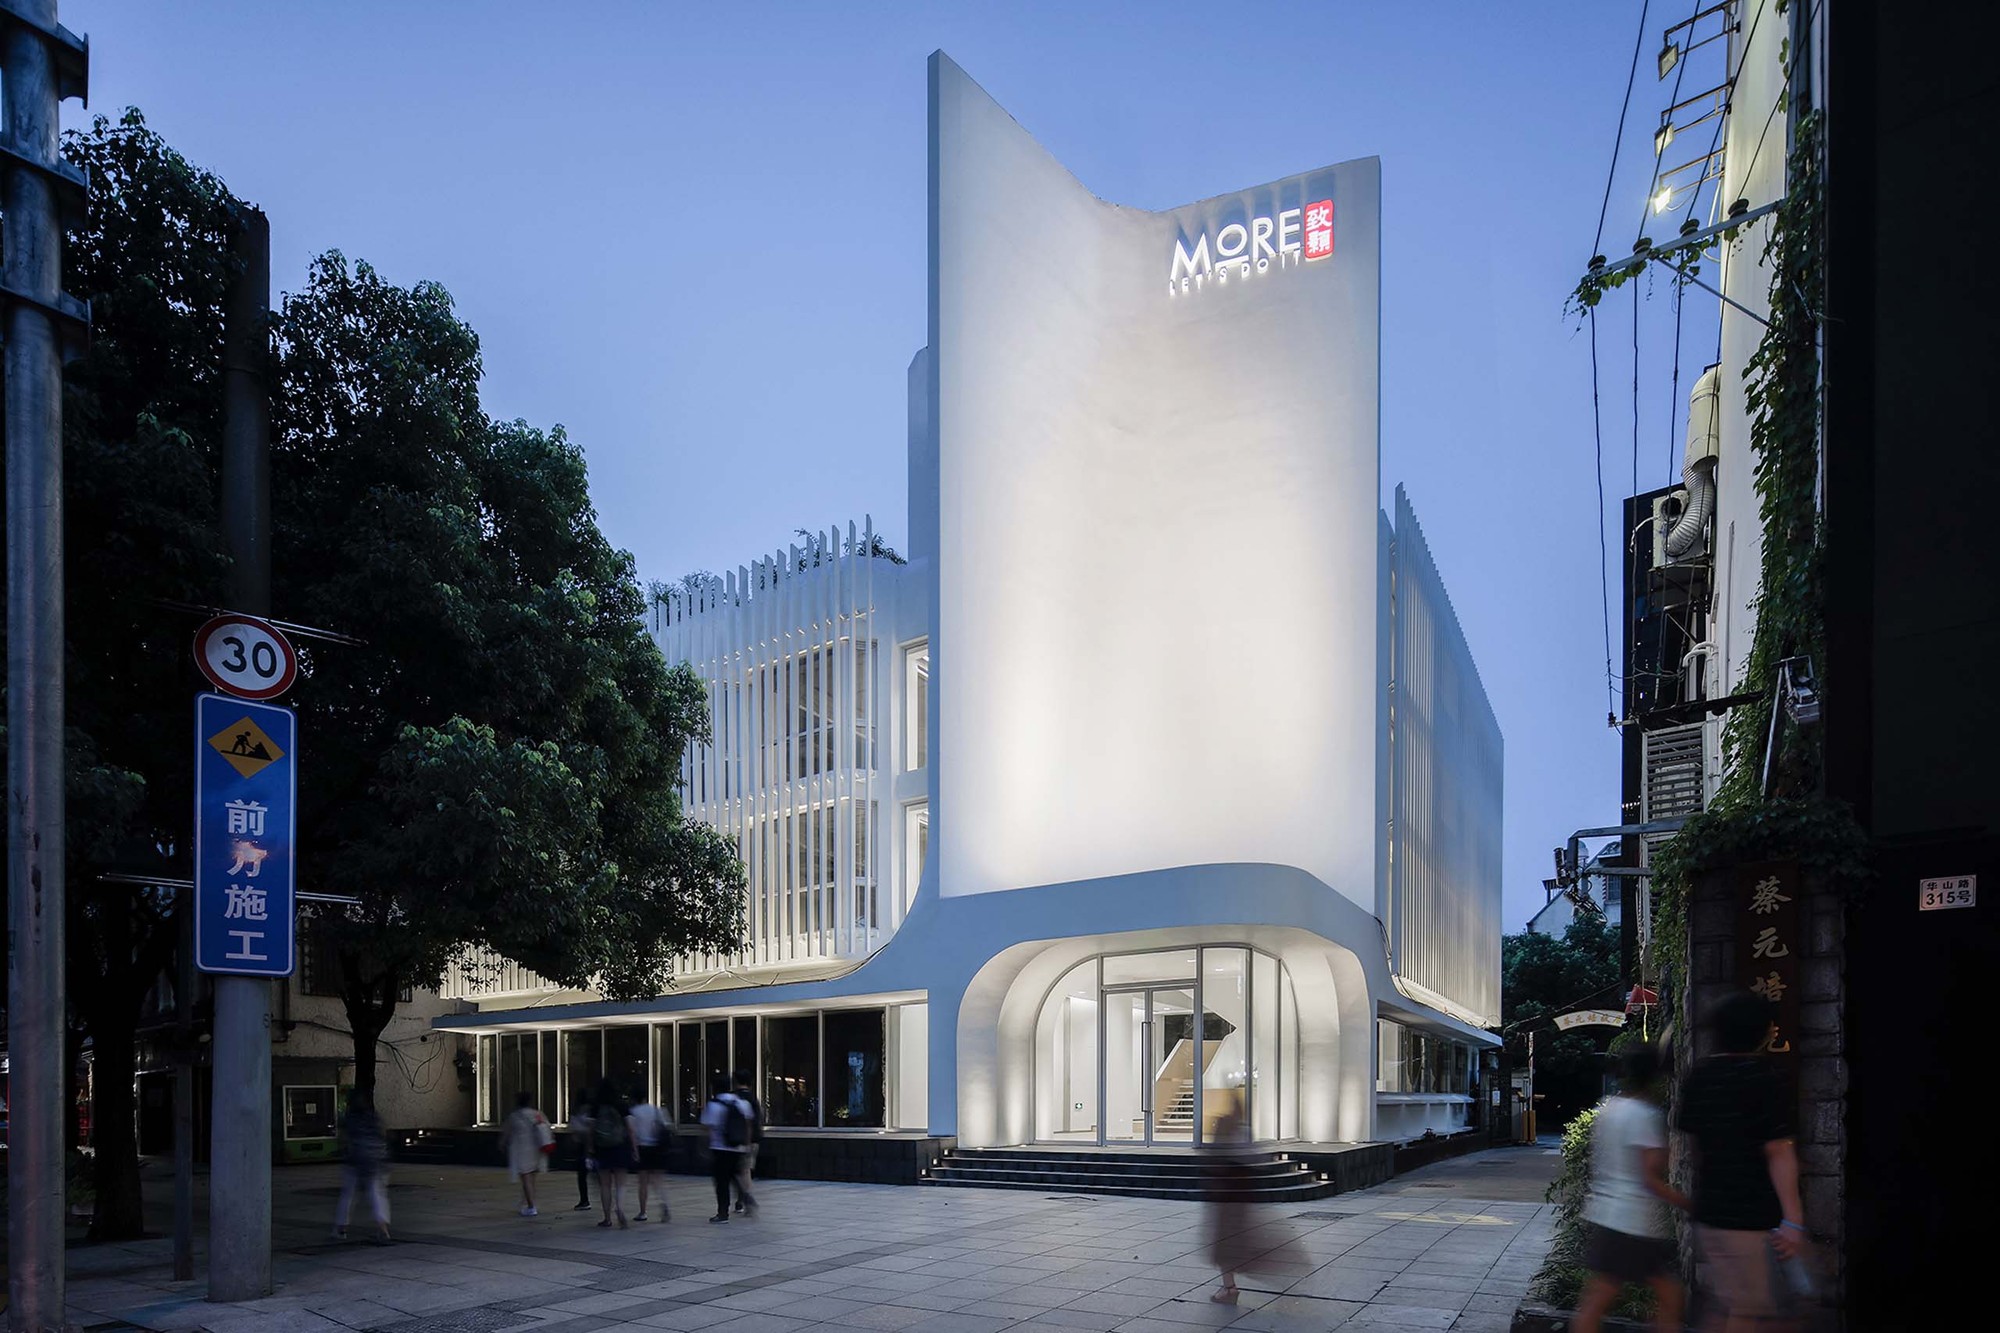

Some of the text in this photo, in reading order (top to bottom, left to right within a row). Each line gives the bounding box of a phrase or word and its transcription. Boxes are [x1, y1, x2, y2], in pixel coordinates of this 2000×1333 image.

[1170, 208, 1301, 282] MORE
[221, 636, 277, 678] 30
[224, 799, 269, 961] 前方施工
[1925, 890, 1972, 907] 315号
[1926, 879, 1970, 892] 华山路
